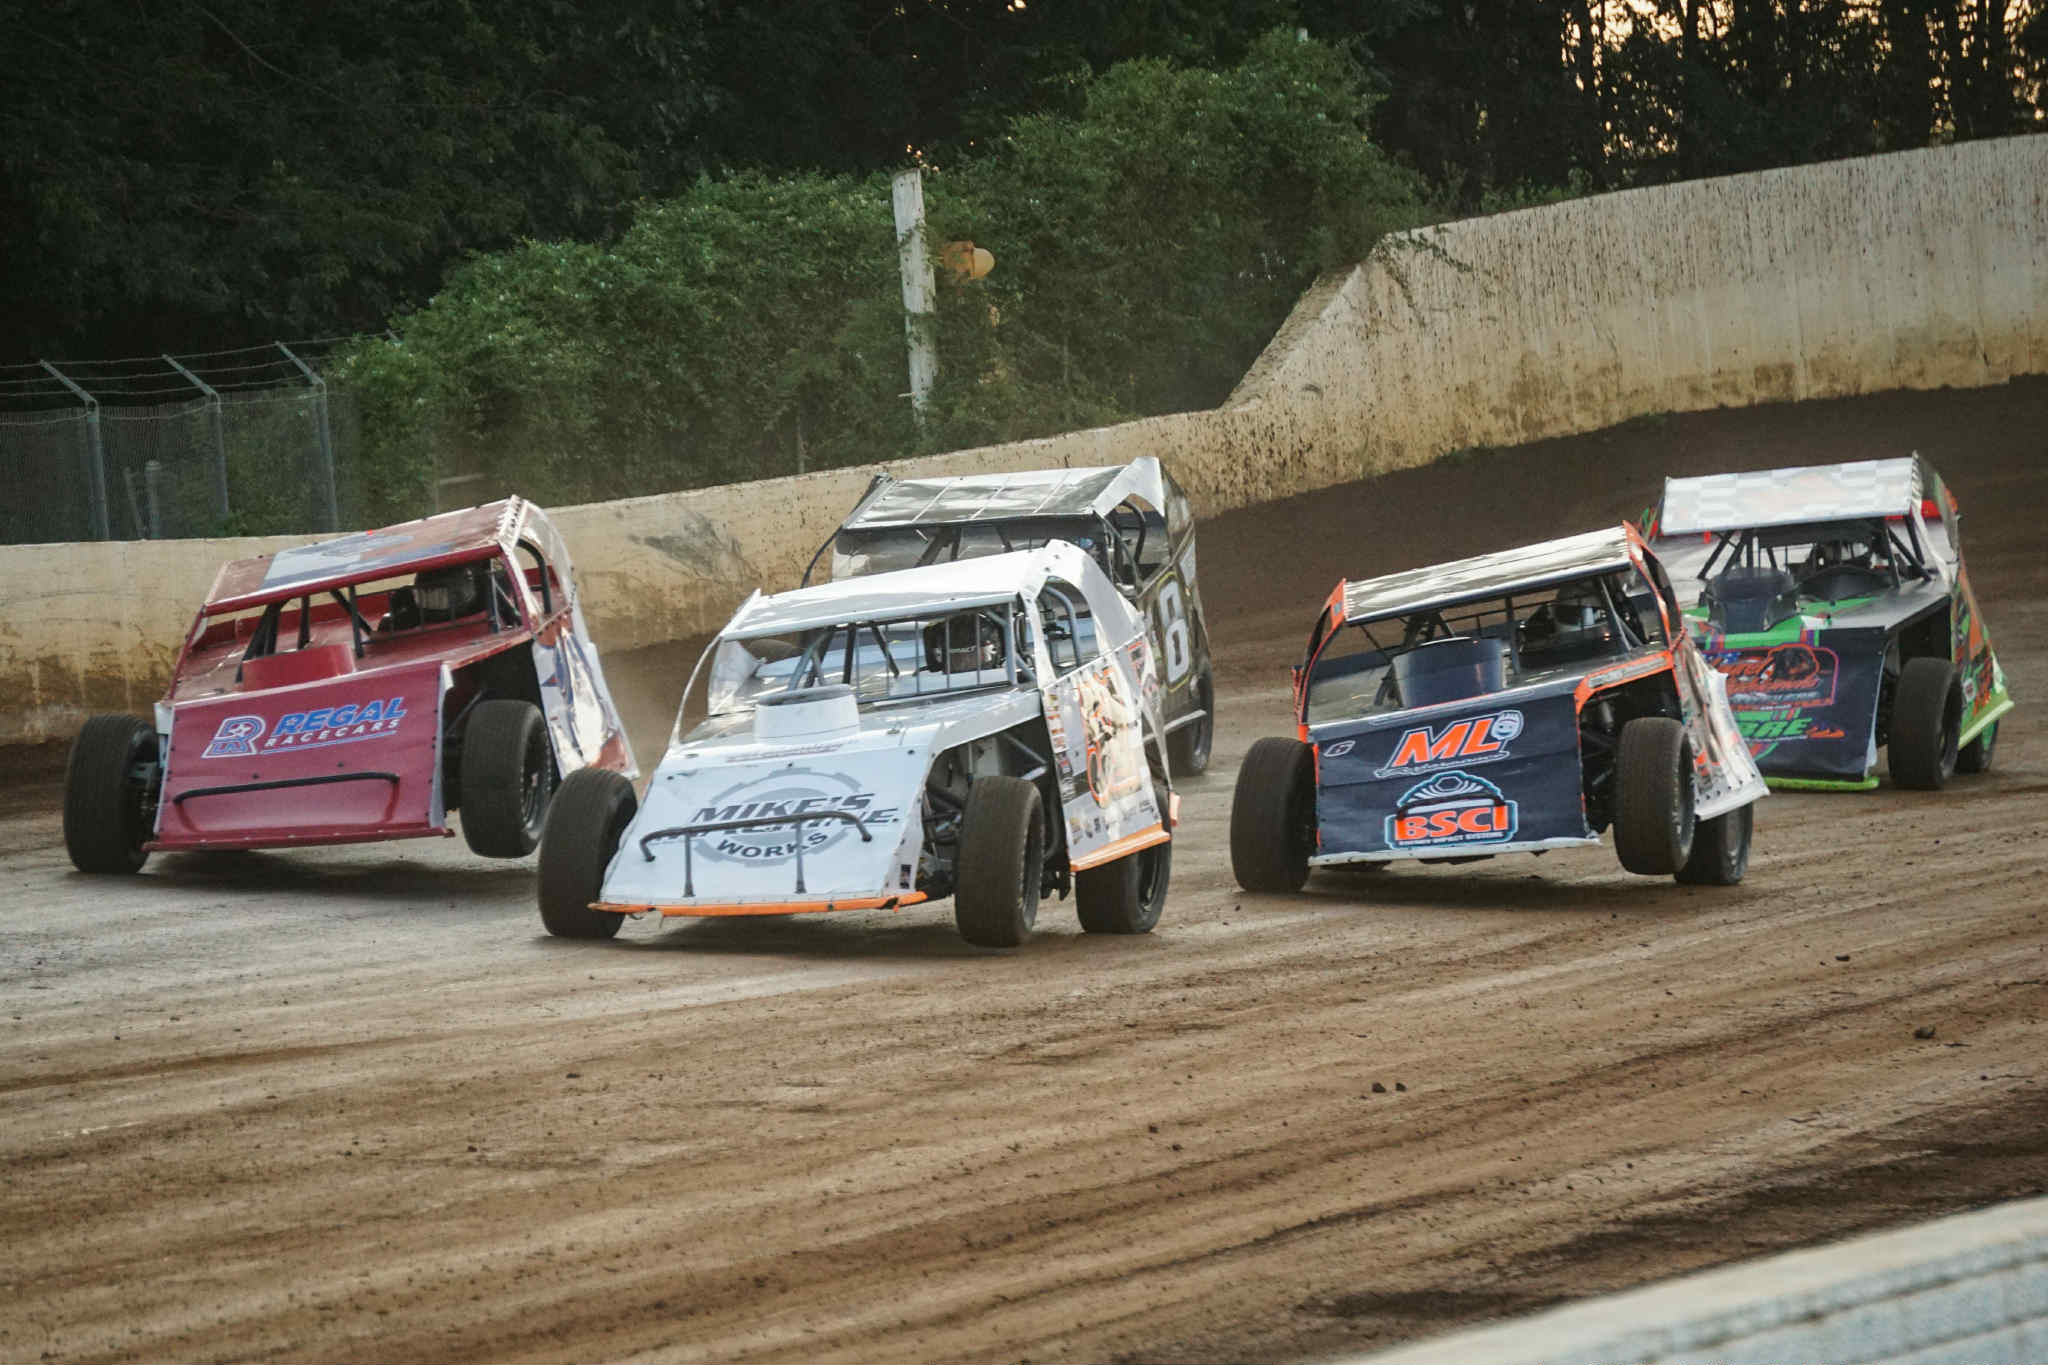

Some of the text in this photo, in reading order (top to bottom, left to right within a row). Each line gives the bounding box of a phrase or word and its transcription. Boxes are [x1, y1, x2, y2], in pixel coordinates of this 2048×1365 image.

[271, 696, 407, 737] REGAL
[264, 719, 400, 748] RACECARS
[690, 793, 876, 824] MIKE'S
[1395, 804, 1509, 841] BSCI
[716, 832, 829, 859] WORKS
